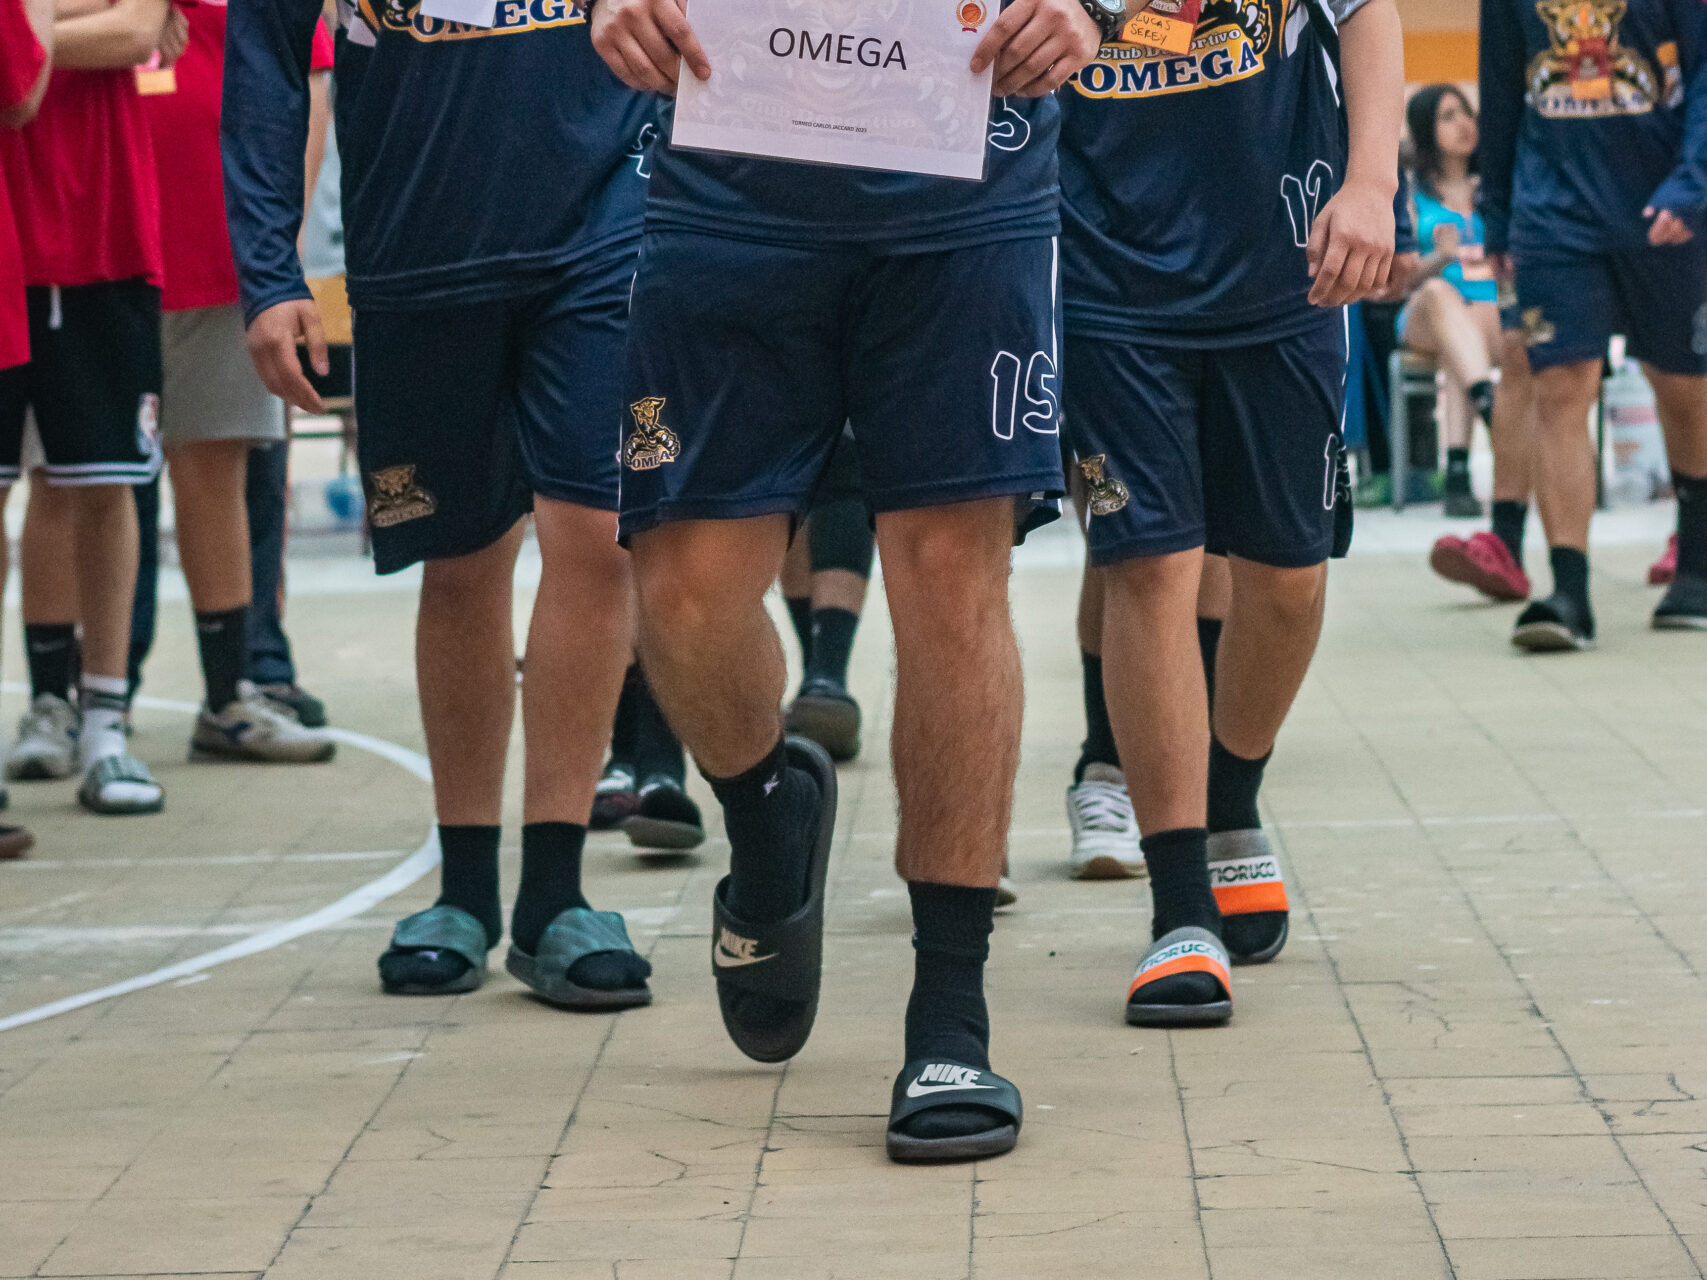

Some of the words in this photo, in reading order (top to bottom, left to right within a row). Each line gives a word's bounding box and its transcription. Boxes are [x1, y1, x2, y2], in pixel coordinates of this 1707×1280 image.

[1135, 14, 1171, 31] LUCAS
[769, 27, 907, 71] OMEGA
[1099, 47, 1142, 60] Club
[1079, 40, 1259, 94] OMEGA
[791, 119, 813, 127] TORNEO
[812, 122, 832, 130] CARLOS
[991, 351, 1058, 440] 15
[919, 1064, 982, 1086] NIKE
